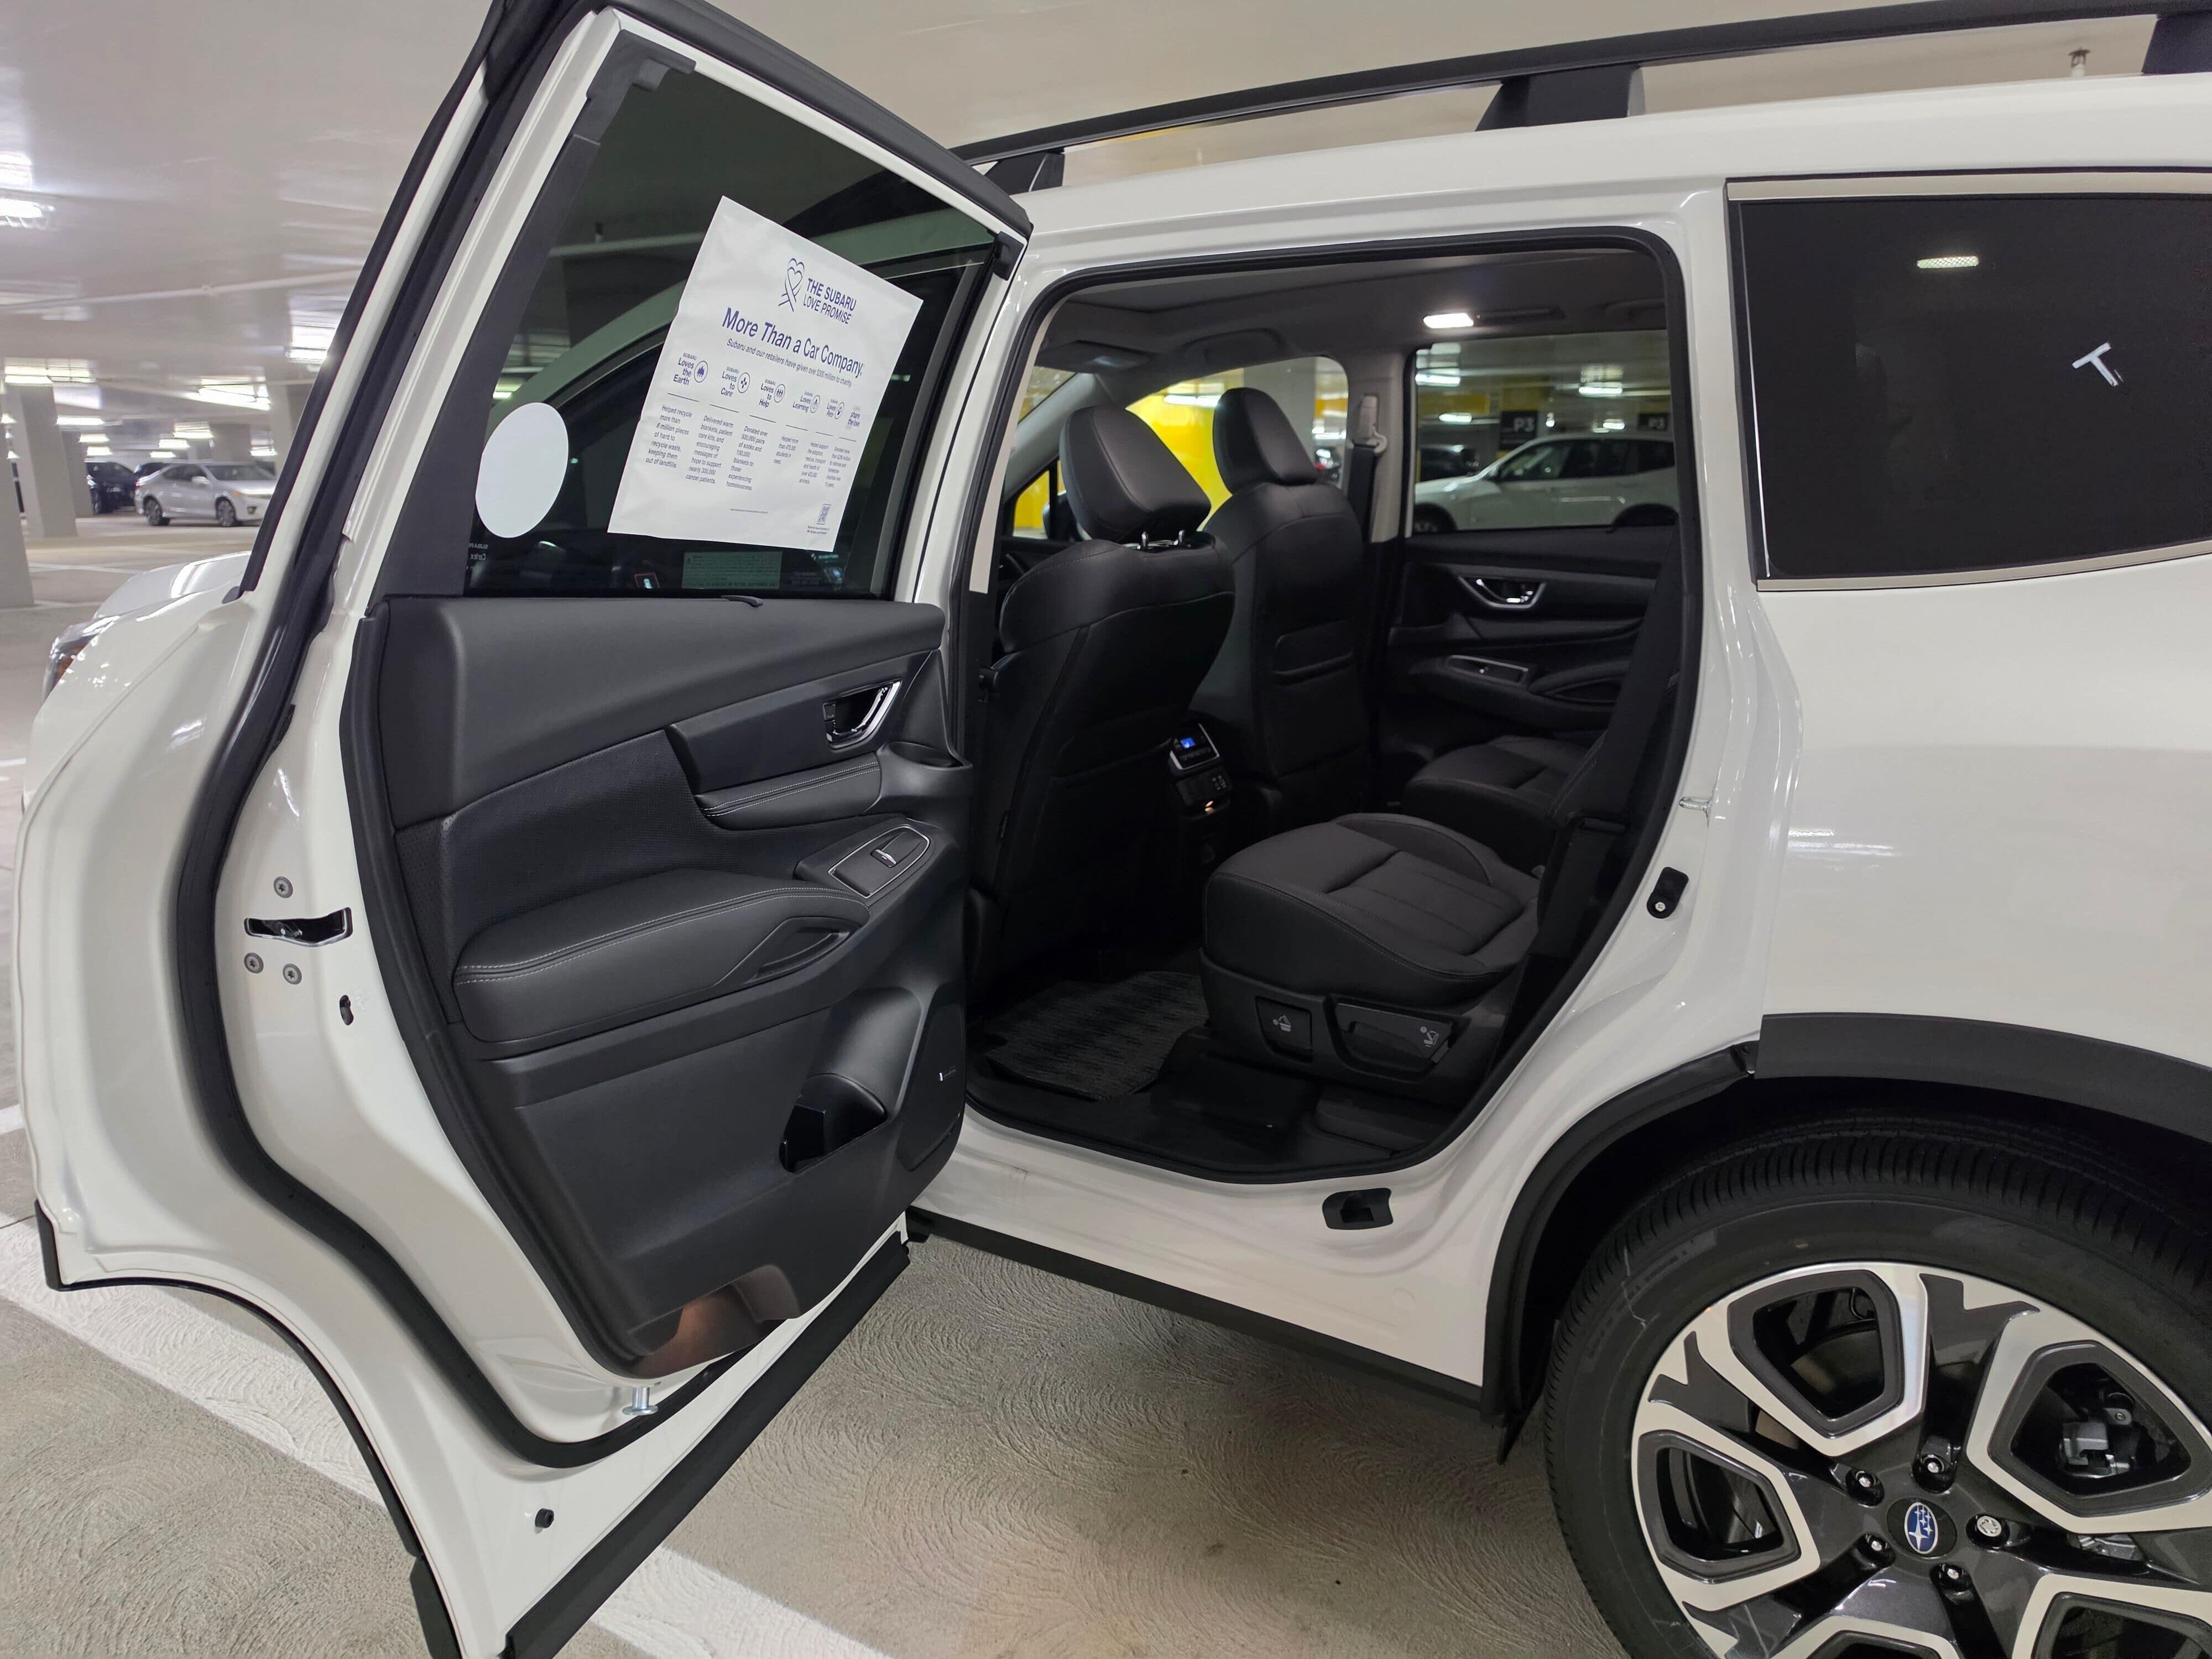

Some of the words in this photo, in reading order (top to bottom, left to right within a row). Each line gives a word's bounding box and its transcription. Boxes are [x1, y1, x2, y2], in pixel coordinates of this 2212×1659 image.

[807, 278, 823, 296] THE
[825, 287, 857, 311] SUBARU
[804, 294, 821, 311] LOVE
[821, 303, 852, 324] PROMISE
[722, 307, 758, 337] More
[761, 322, 791, 349] Than
[793, 340, 801, 353] a
[804, 338, 820, 359] Car
[727, 338, 745, 351] Subaru
[765, 353, 785, 364] retailers
[785, 359, 796, 368] have
[796, 364, 808, 372] given
[679, 357, 694, 369] Loves
[682, 368, 691, 377] the
[722, 371, 737, 382] Loves
[674, 374, 689, 385] Earth
[721, 388, 733, 397] Care
[761, 383, 774, 393] Loves
[759, 399, 769, 408] Help
[800, 395, 811, 404] Loves
[662, 405, 677, 414] Helped
[793, 401, 809, 413] Learning
[703, 415, 722, 425] Delivered
[675, 427, 689, 435] pieces
[744, 426, 760, 435] Donated
[697, 441, 719, 452] encouraging
[649, 448, 666, 458] keeping
